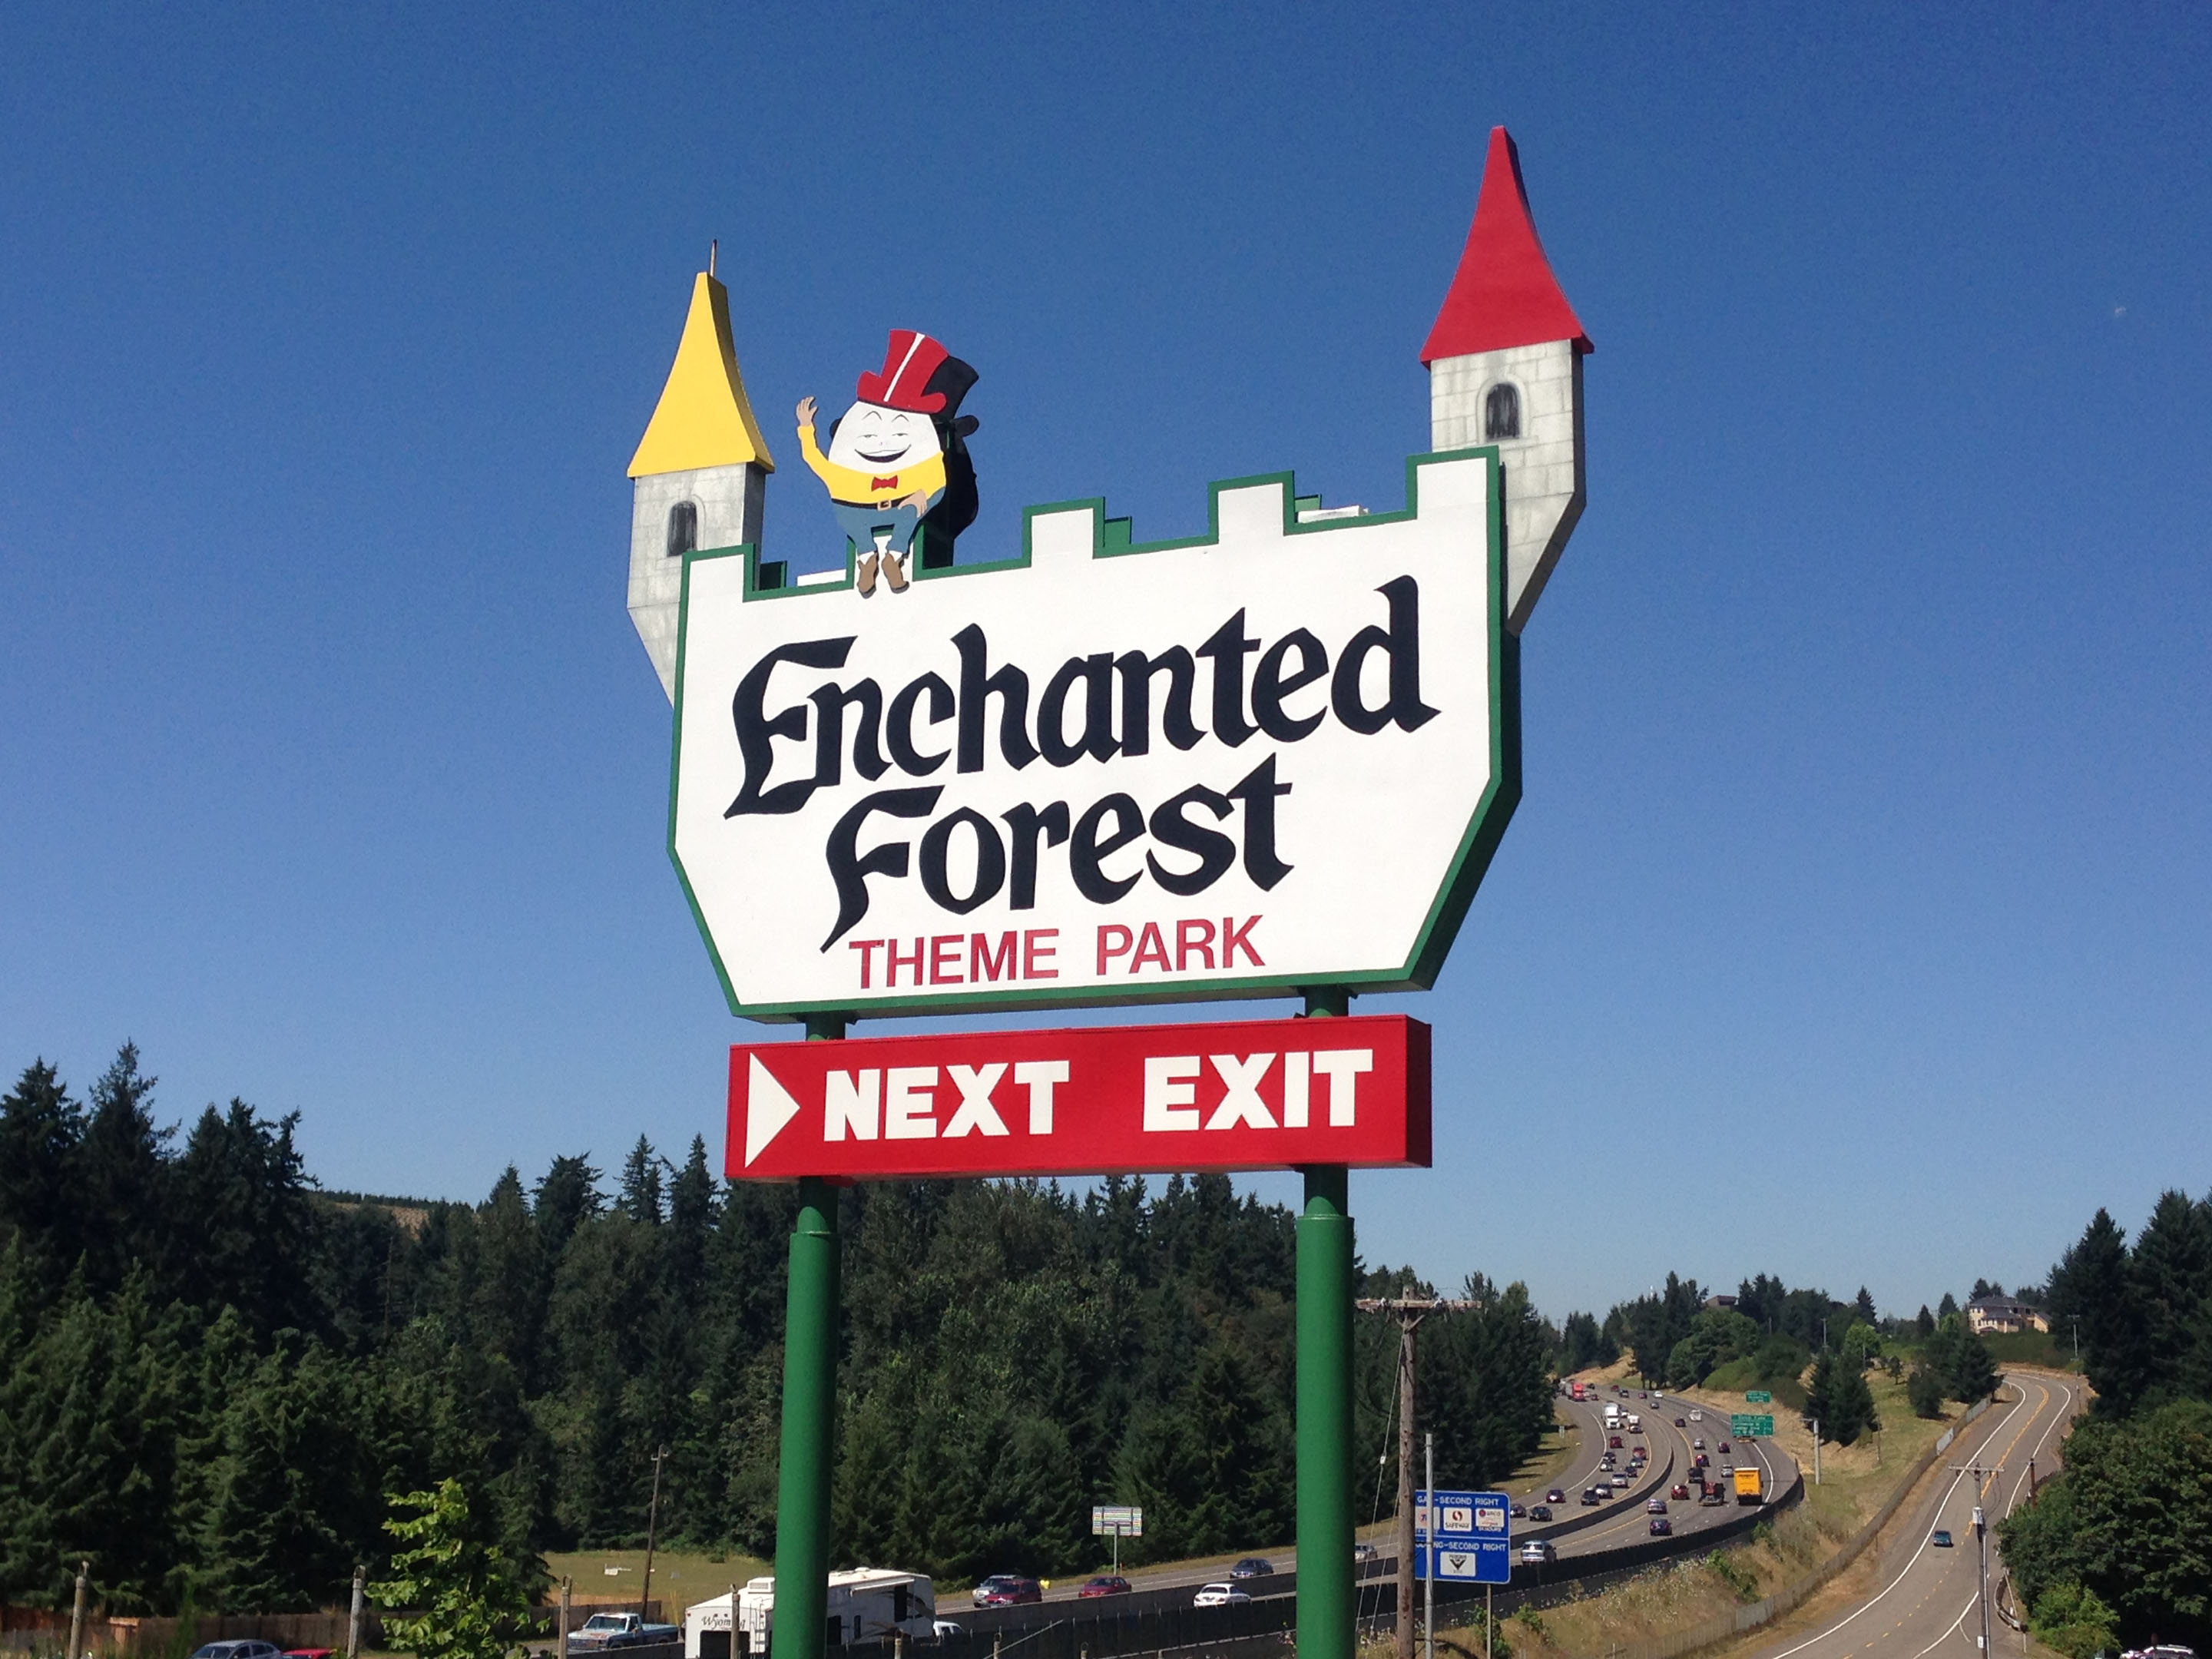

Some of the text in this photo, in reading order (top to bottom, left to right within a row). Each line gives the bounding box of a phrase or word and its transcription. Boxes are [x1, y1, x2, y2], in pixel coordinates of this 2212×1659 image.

[724, 575, 1442, 819] Enchanted
[820, 753, 1295, 953] Forest
[849, 916, 1266, 989] THEME PARK
[823, 1048, 1373, 1141] NEXT EXIT
[1475, 1497, 1500, 1506] RIGHT
[1482, 1543, 1507, 1552] RIGHT
